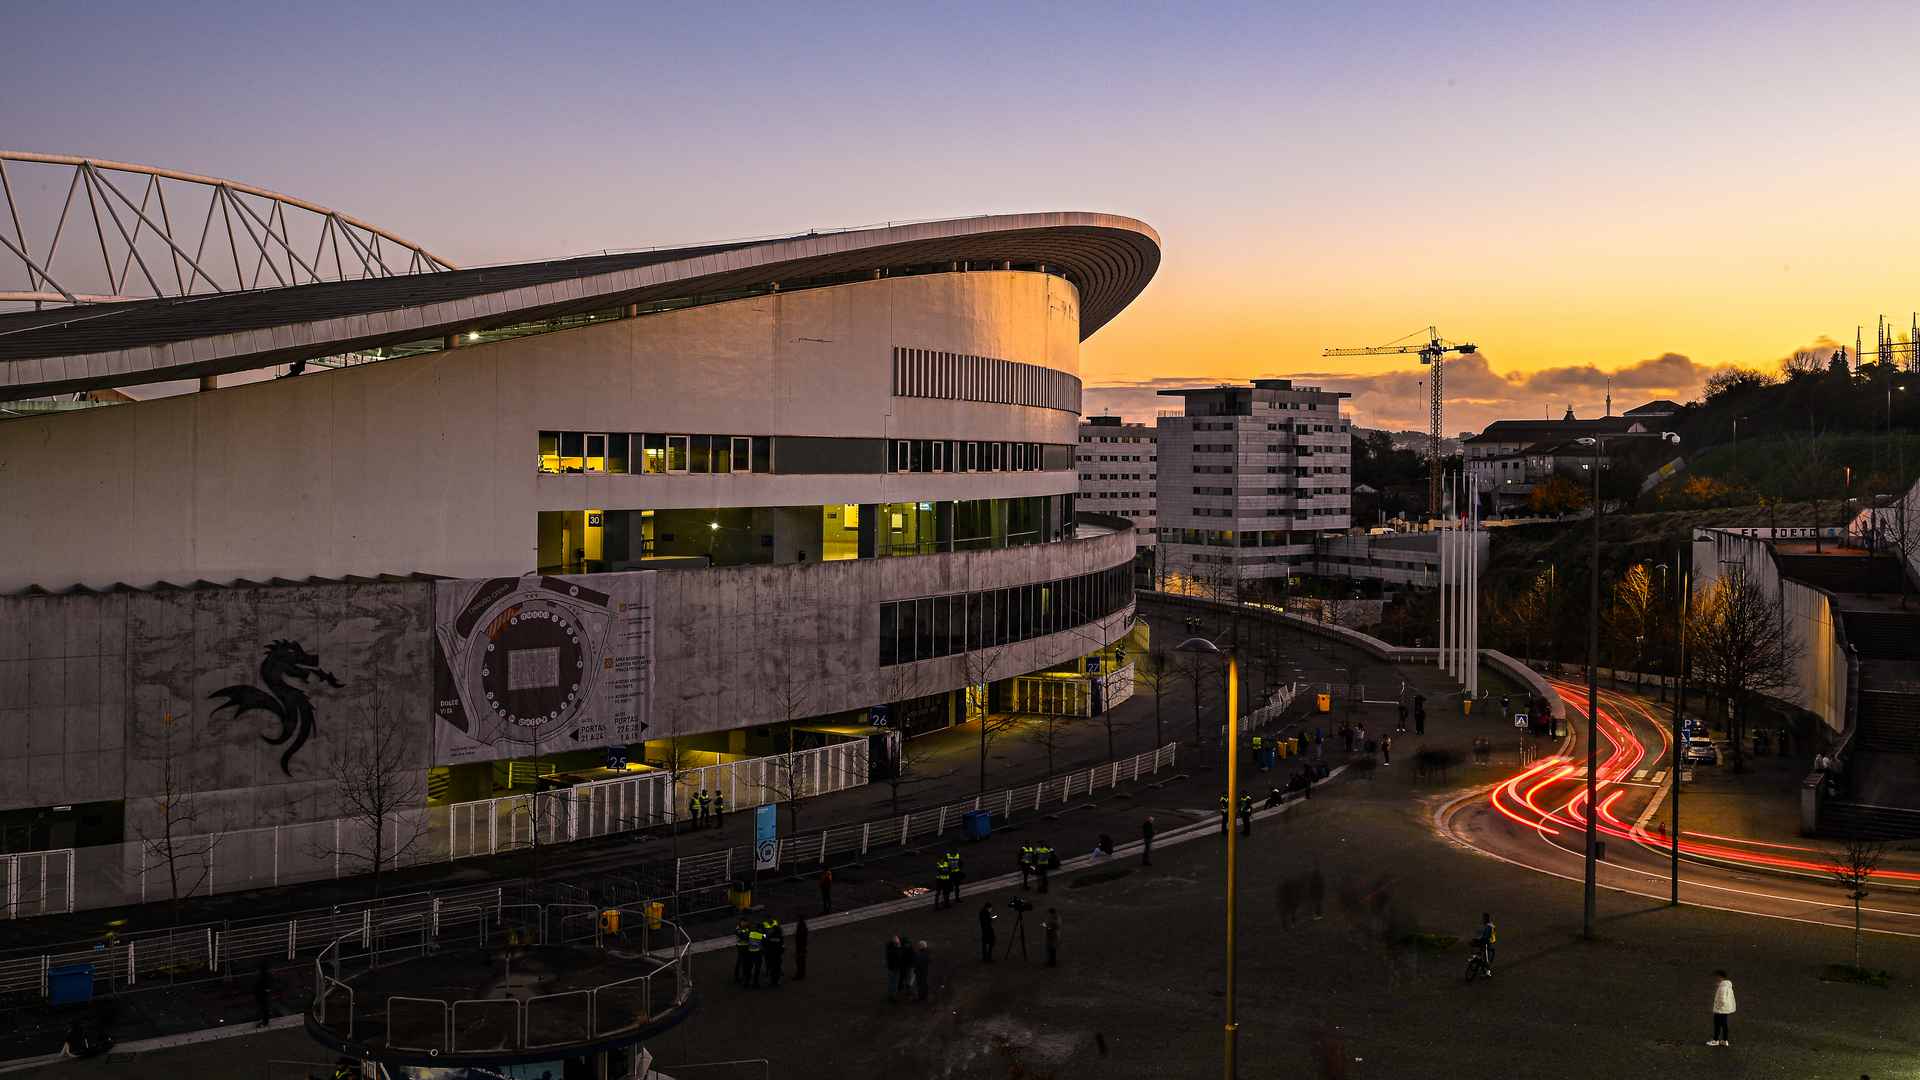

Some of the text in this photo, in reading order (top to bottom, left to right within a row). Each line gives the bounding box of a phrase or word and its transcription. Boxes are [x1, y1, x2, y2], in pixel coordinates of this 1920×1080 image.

[590, 516, 600, 525] 30
[1088, 663, 1099, 672] 27
[440, 699, 459, 707] DOLCE
[872, 714, 887, 726] 26
[1684, 719, 1692, 728] P
[610, 756, 627, 769] 25
